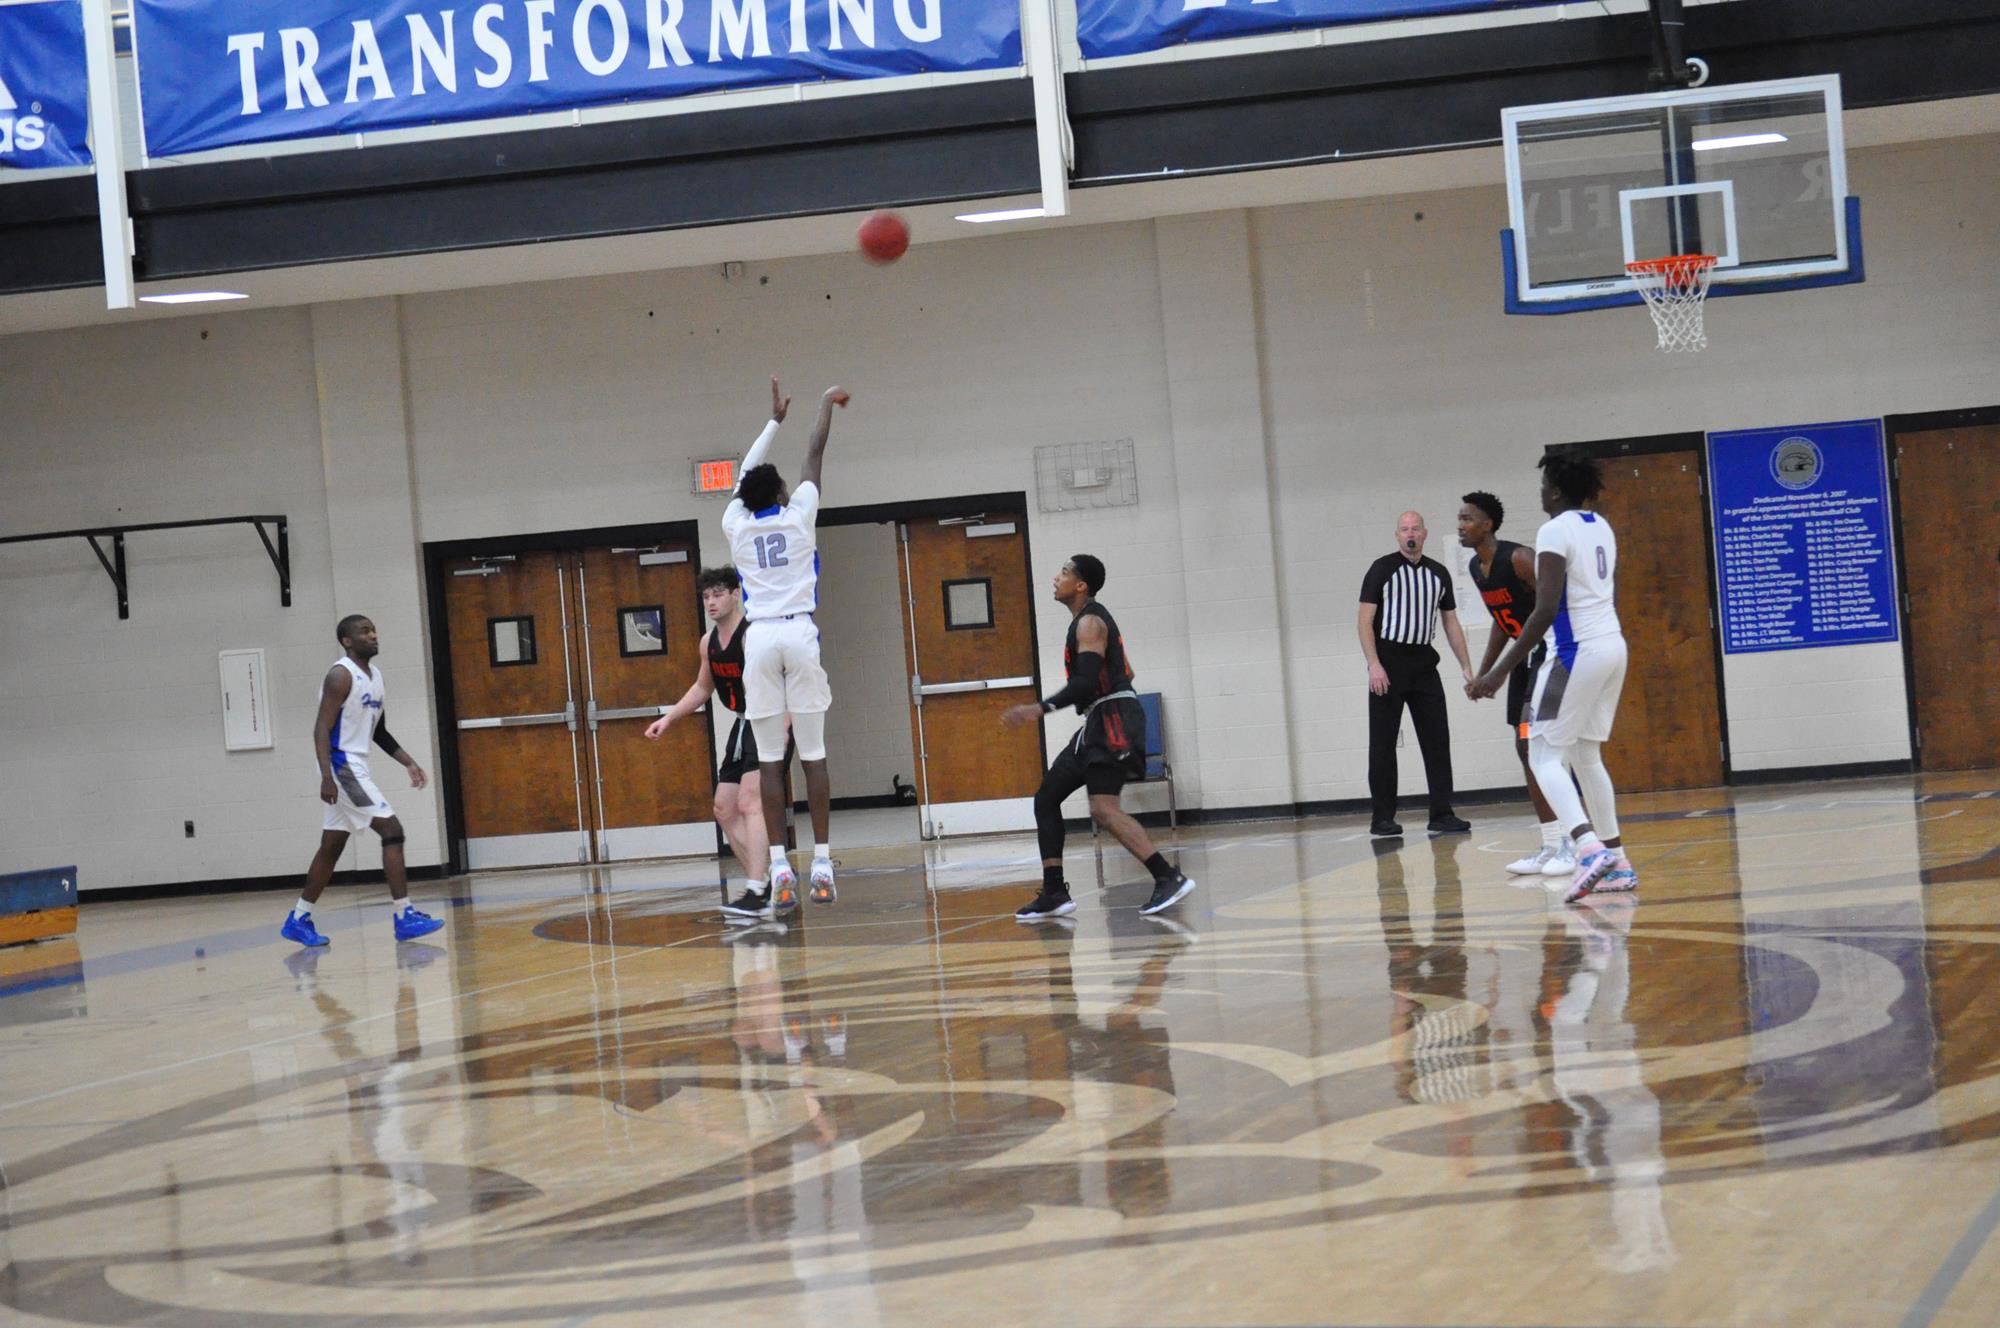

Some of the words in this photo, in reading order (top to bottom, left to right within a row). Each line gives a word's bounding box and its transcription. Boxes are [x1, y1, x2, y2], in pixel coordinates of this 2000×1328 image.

[226, 0, 943, 115] TRANSFORMING
[701, 461, 733, 490] EXIT
[754, 533, 789, 569] 12
[1595, 545, 1608, 580] 0
[1492, 608, 1521, 638] 15
